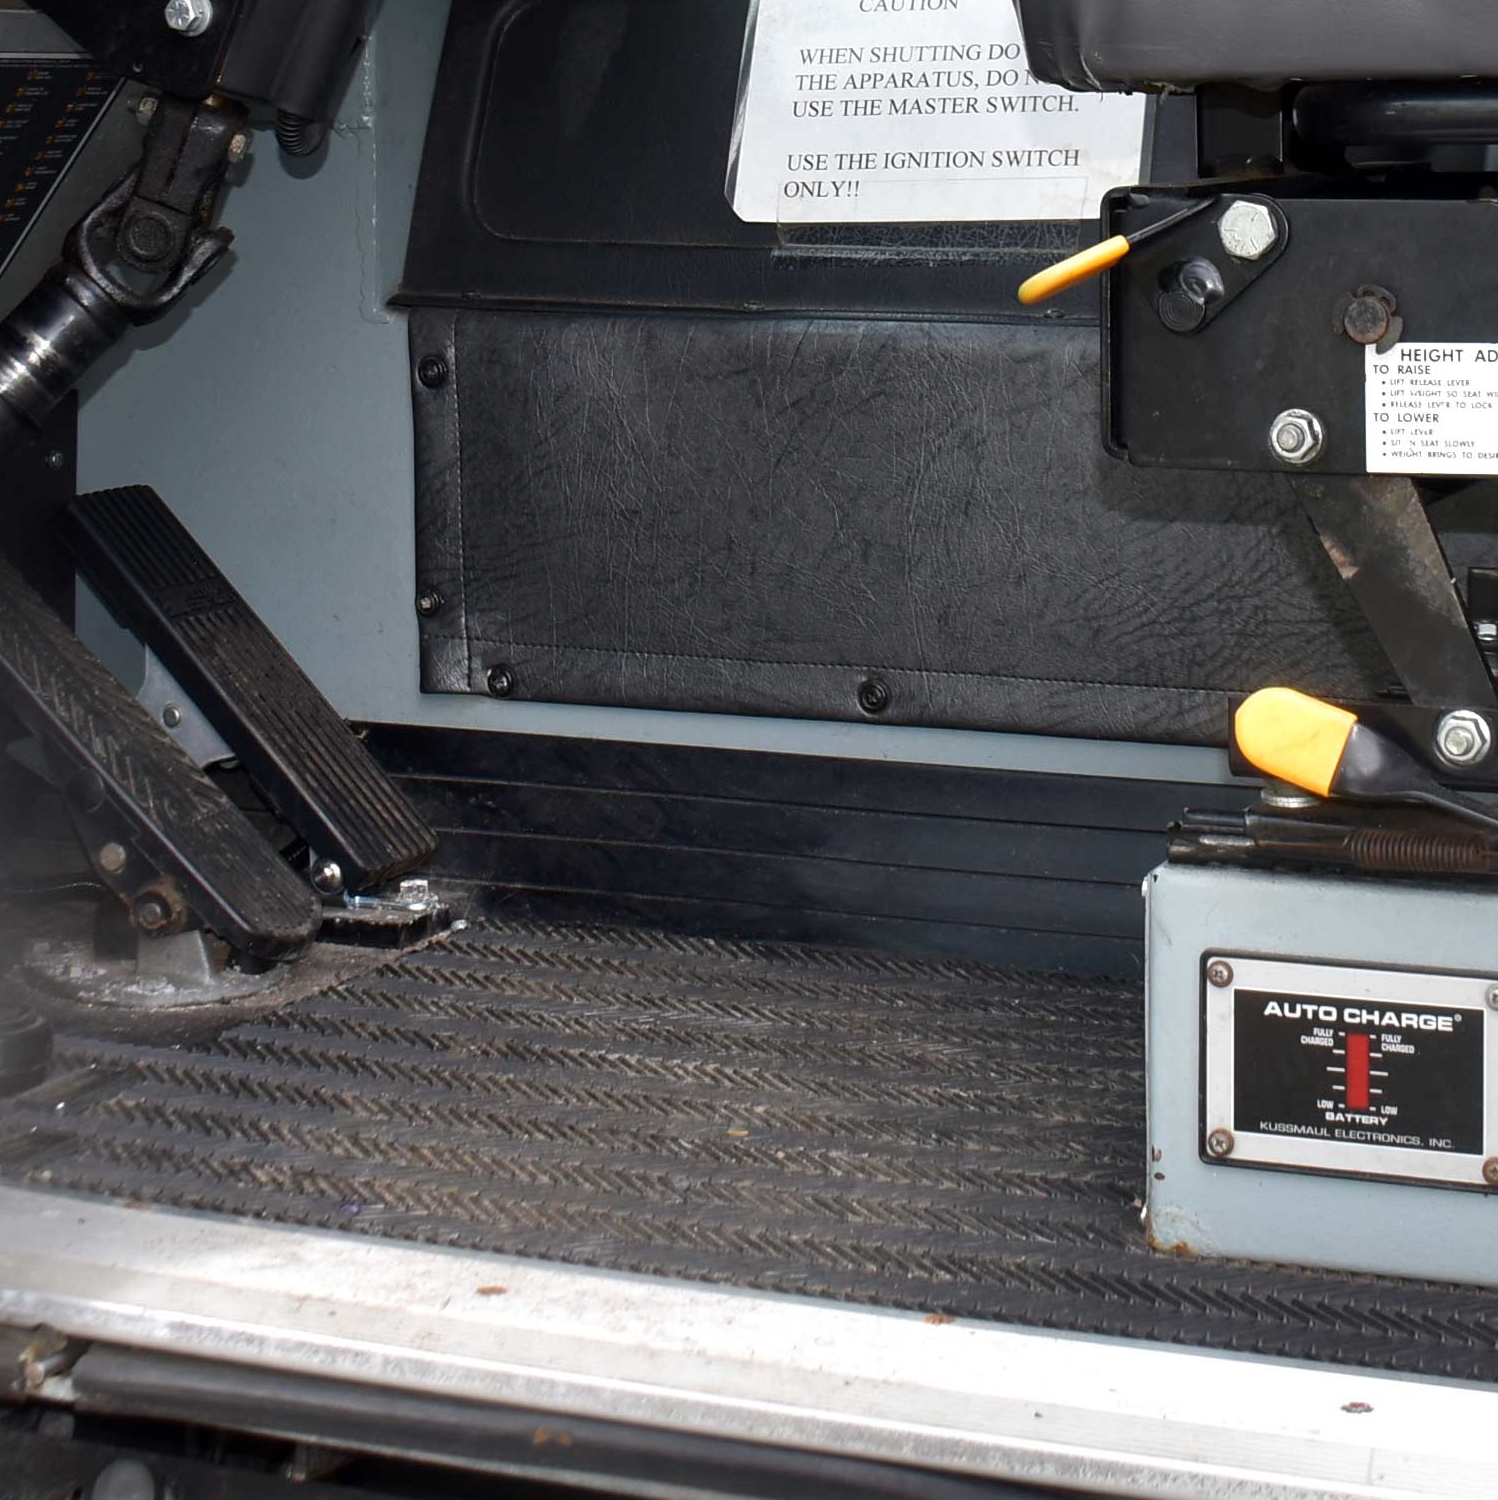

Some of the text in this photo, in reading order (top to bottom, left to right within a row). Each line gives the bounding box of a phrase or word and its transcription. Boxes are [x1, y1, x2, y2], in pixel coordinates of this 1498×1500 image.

[799, 43, 1021, 65] WHEN SHUTTING DO
[795, 73, 838, 91] THE
[843, 70, 980, 92] APPARATUS,
[986, 69, 1020, 86] DO
[793, 94, 1080, 117] USE THE MASTER SWITCH.
[787, 148, 1081, 171] USE THE IGNITION SWITCH
[783, 180, 860, 199] ONLY!!
[1401, 349, 1463, 363] HEIGHT
[1373, 365, 1431, 375] TO RAISE
[1410, 379, 1442, 387] RELEASE
[1447, 379, 1470, 387] LEVER
[1373, 413, 1439, 424] TO LOWER
[1444, 440, 1475, 448] SLOWLY
[1391, 451, 1422, 459] WEIGHT
[1263, 1001, 1337, 1020] AUTO
[1313, 1027, 1333, 1038] FULLY
[1381, 1033, 1402, 1043] FULLY
[1301, 1036, 1334, 1047] CHARGED
[1381, 1042, 1415, 1054] CHARGED
[1317, 1100, 1334, 1109] LOW
[1381, 1106, 1398, 1116] LOW
[1325, 1111, 1389, 1126] BATTERY
[1260, 1121, 1331, 1138] KUSSMAUL
[1429, 1137, 1455, 1149] INC.
